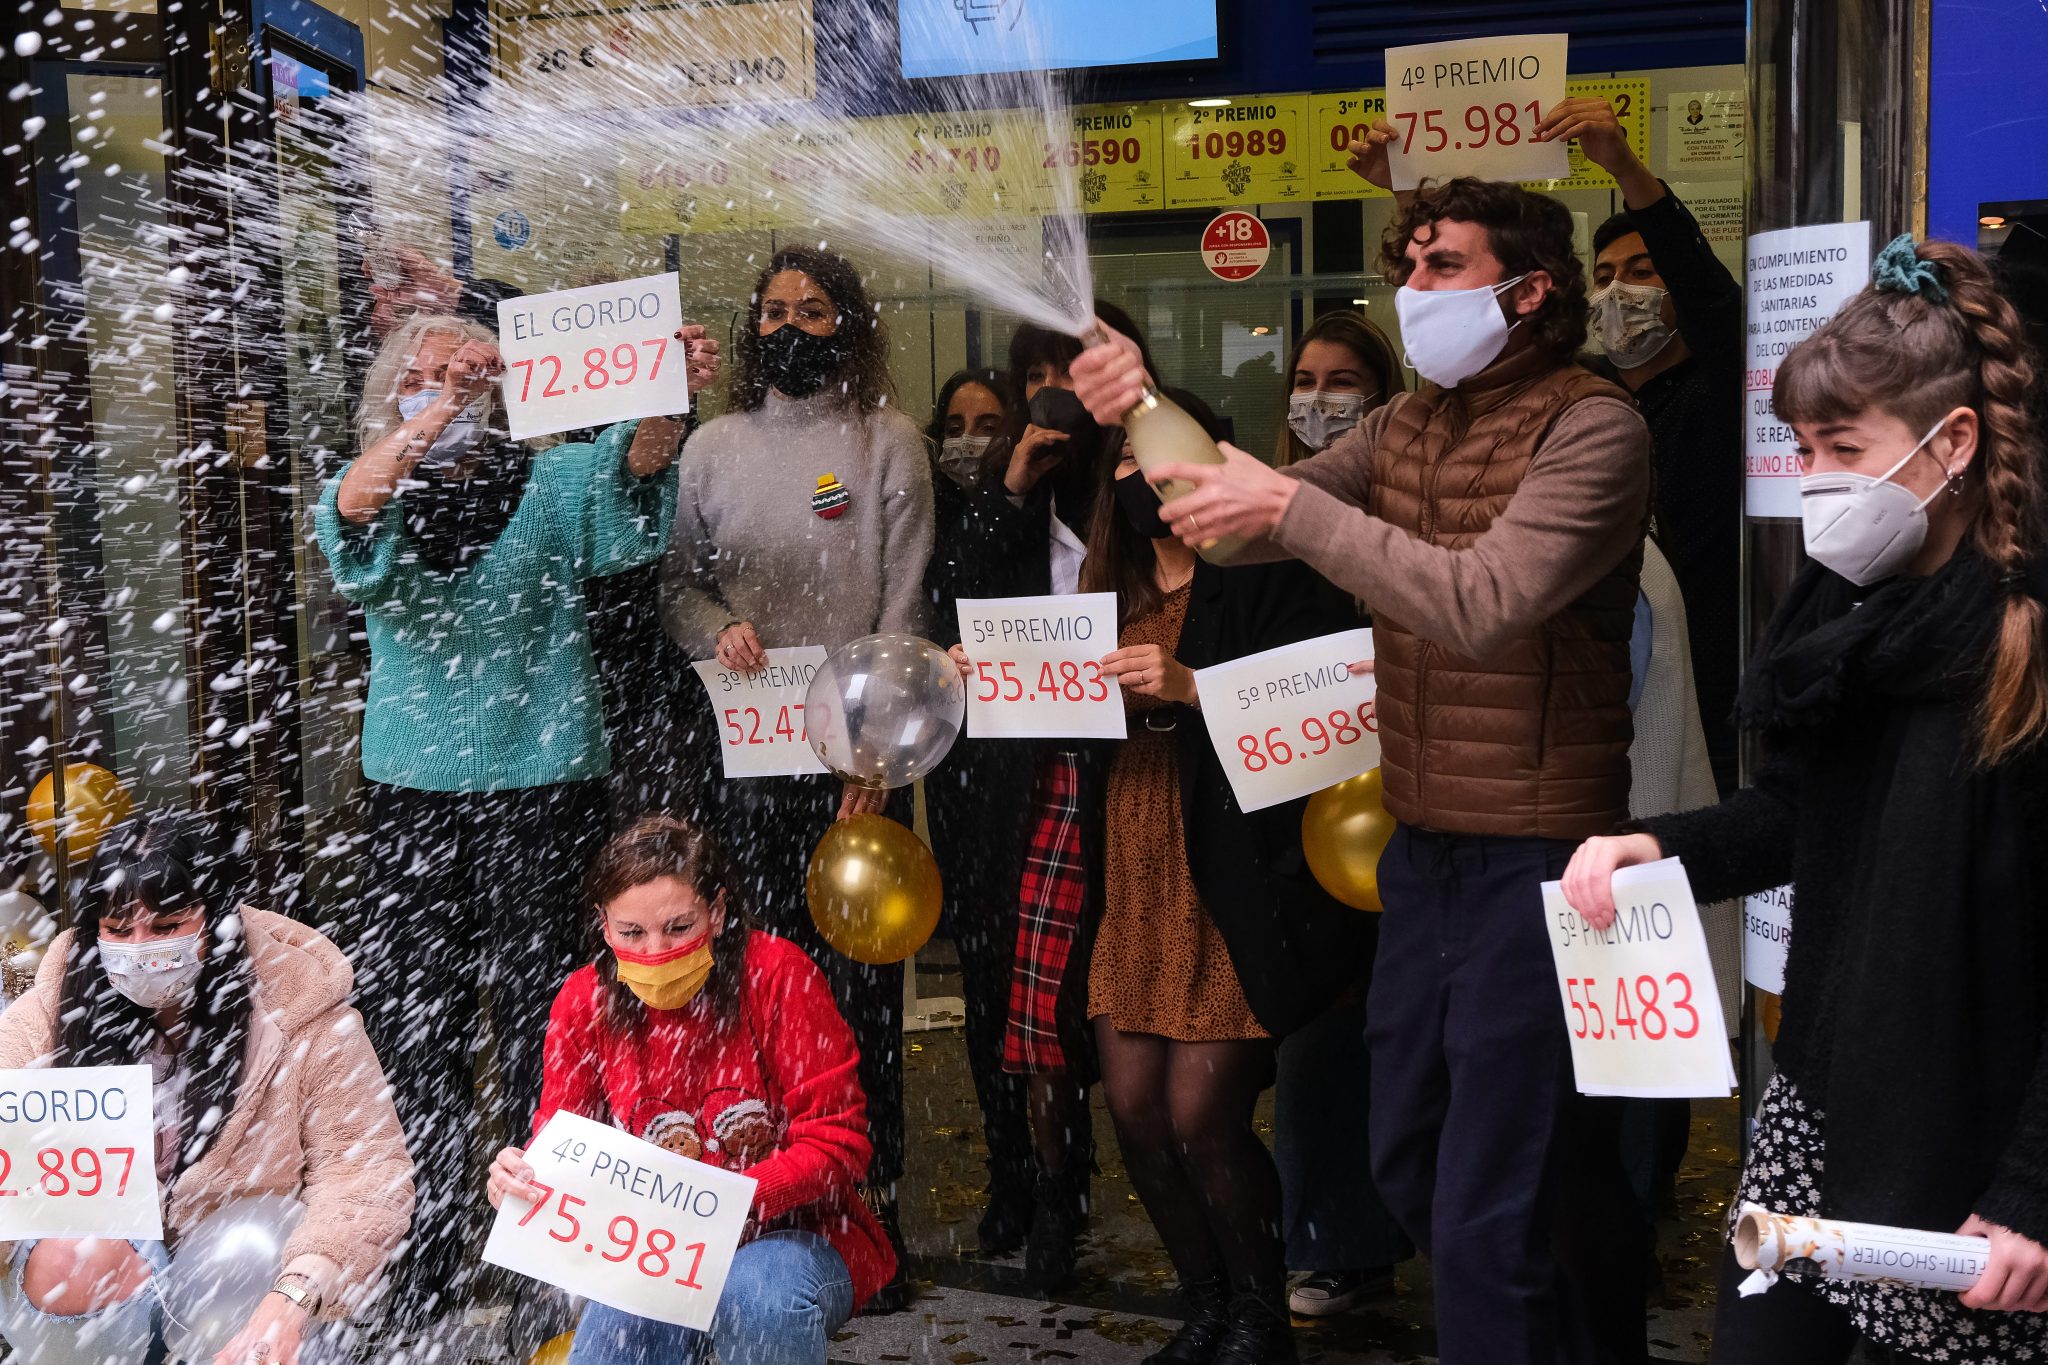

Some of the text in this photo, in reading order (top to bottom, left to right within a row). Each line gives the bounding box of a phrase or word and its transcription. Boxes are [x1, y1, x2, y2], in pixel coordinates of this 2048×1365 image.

[1434, 55, 1541, 89] PREMIO
[1215, 104, 1277, 122] PREMIO
[1364, 97, 1385, 113] PR
[934, 122, 992, 140] PREMIO
[1073, 114, 1133, 132] PREMIO
[1395, 99, 1544, 155] 75.981
[1042, 137, 1142, 169] 26590
[1185, 128, 1287, 160] 10989
[1216, 218, 1253, 241] +18
[1726, 218, 1743, 226] PREM
[1749, 247, 1848, 272] EN CUMPLIMIENTO
[1753, 272, 1834, 293] DE LAS MEDIDAS
[513, 292, 661, 341] EL GORDO
[1760, 295, 1817, 313] SANITARIAS
[1762, 321, 1773, 334] LA
[1755, 343, 1770, 358] DEL
[511, 337, 669, 403] 72.897
[1756, 427, 1766, 443] SE
[1755, 455, 1782, 473] UNO
[1001, 615, 1093, 644] PREMIO
[747, 663, 819, 691] PREMIO
[976, 660, 1109, 703] 55.483
[1265, 661, 1350, 703] PREMIO
[1237, 701, 1379, 773] 86.986
[1566, 971, 1700, 1041] 55.483
[0, 1087, 128, 1124] GORDO
[590, 1150, 719, 1218] PREMIO
[517, 1178, 707, 1291] 75.981
